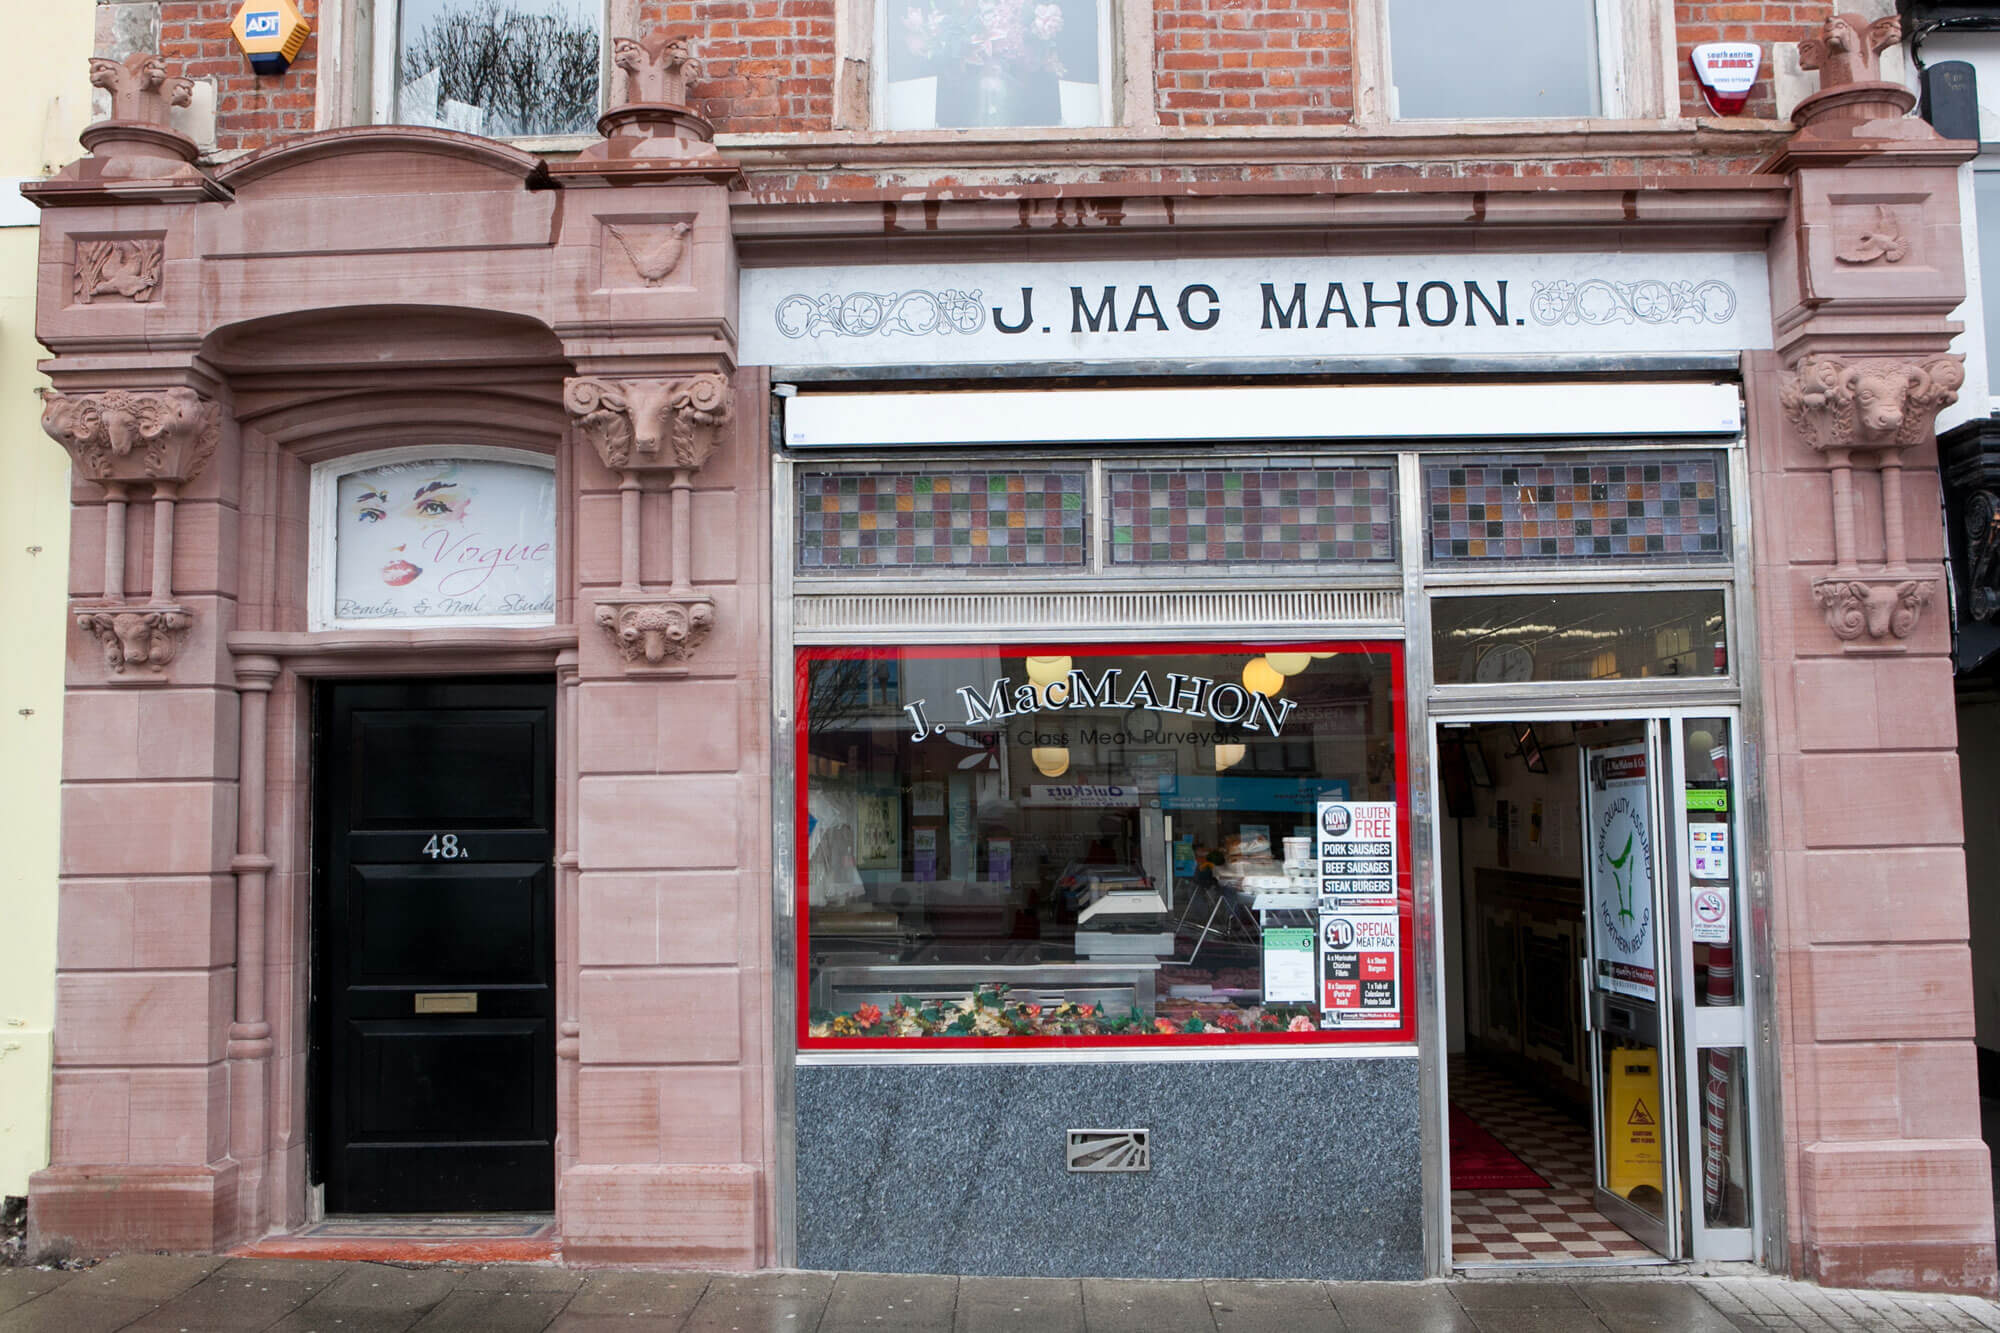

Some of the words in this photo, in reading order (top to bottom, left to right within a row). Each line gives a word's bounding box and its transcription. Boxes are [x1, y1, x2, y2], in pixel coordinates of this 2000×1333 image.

[247, 16, 279, 32] ADT
[992, 286, 1051, 334] J.
[1070, 283, 1221, 333] MAC
[1260, 280, 1525, 329] MAHON.
[422, 529, 550, 597] Vogue
[339, 598, 404, 617] Beauty
[412, 598, 433, 614] &
[438, 595, 486, 615] Nail
[903, 699, 946, 743] J.
[956, 668, 1298, 737] MacMAHON
[1017, 729, 1070, 746] Class
[1080, 728, 1134, 745] Meat
[1143, 727, 1241, 748] Purveyors
[1325, 811, 1348, 825] NOW
[1355, 807, 1391, 819] GLUTEN
[1603, 797, 1631, 828] QUALITY
[1355, 820, 1391, 838] FREE
[1324, 844, 1347, 856] PORK
[1347, 844, 1391, 856] SAUSAGES
[1325, 862, 1347, 874] BEEF
[1347, 862, 1390, 874] SAUSAGES
[1325, 881, 1351, 893] STEAK
[1352, 881, 1391, 893] BURGERS
[1327, 924, 1352, 945] £10
[1356, 922, 1395, 936] SPECIAL
[1601, 900, 1631, 955] NORTHERN
[1631, 907, 1650, 954] IRELAND
[1356, 937, 1376, 947] MEAT
[1377, 937, 1396, 947] PACK
